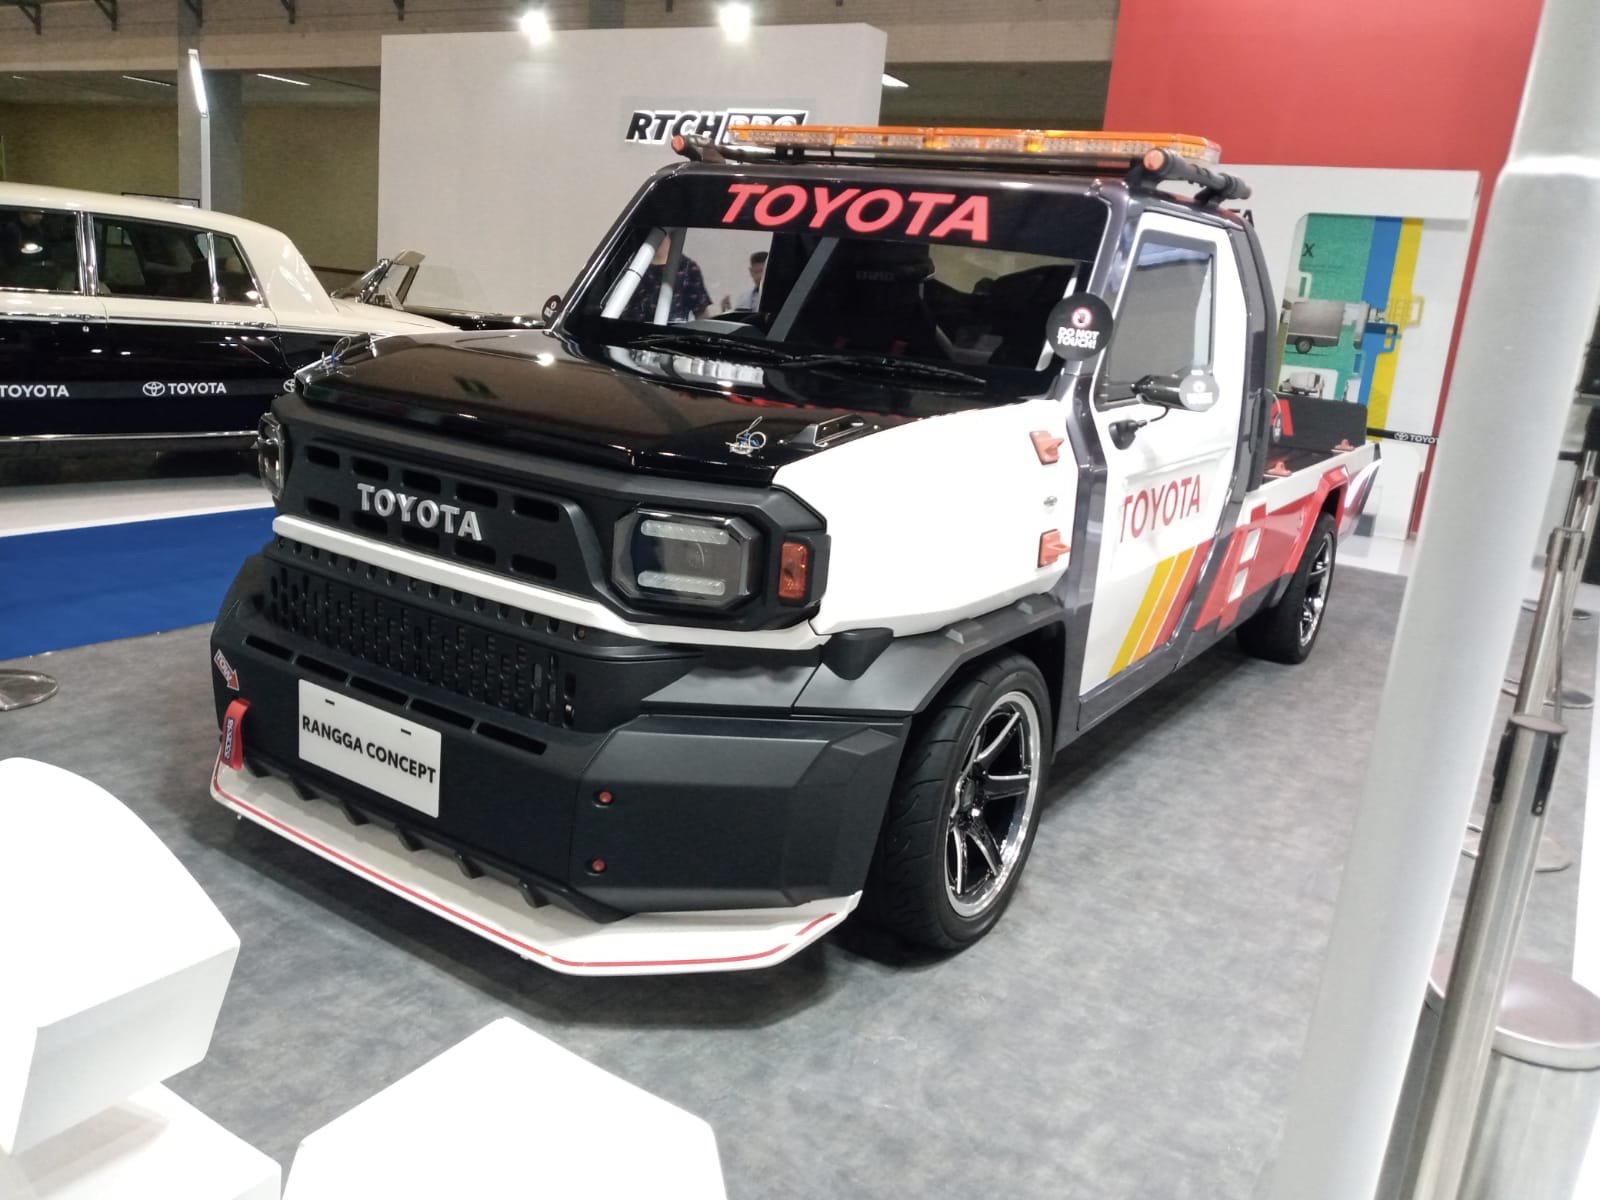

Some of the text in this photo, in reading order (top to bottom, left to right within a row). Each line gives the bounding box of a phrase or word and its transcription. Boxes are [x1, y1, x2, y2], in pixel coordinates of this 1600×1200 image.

[722, 184, 989, 242] TOYOTA
[1058, 327, 1100, 340] DO NOT
[0, 384, 69, 397] TOYOTA
[168, 382, 227, 394] TOYOTA
[357, 483, 482, 541] TOYOTA
[1119, 474, 1201, 543] TOYOTA
[302, 714, 436, 783] RANGGA CONCEPT
